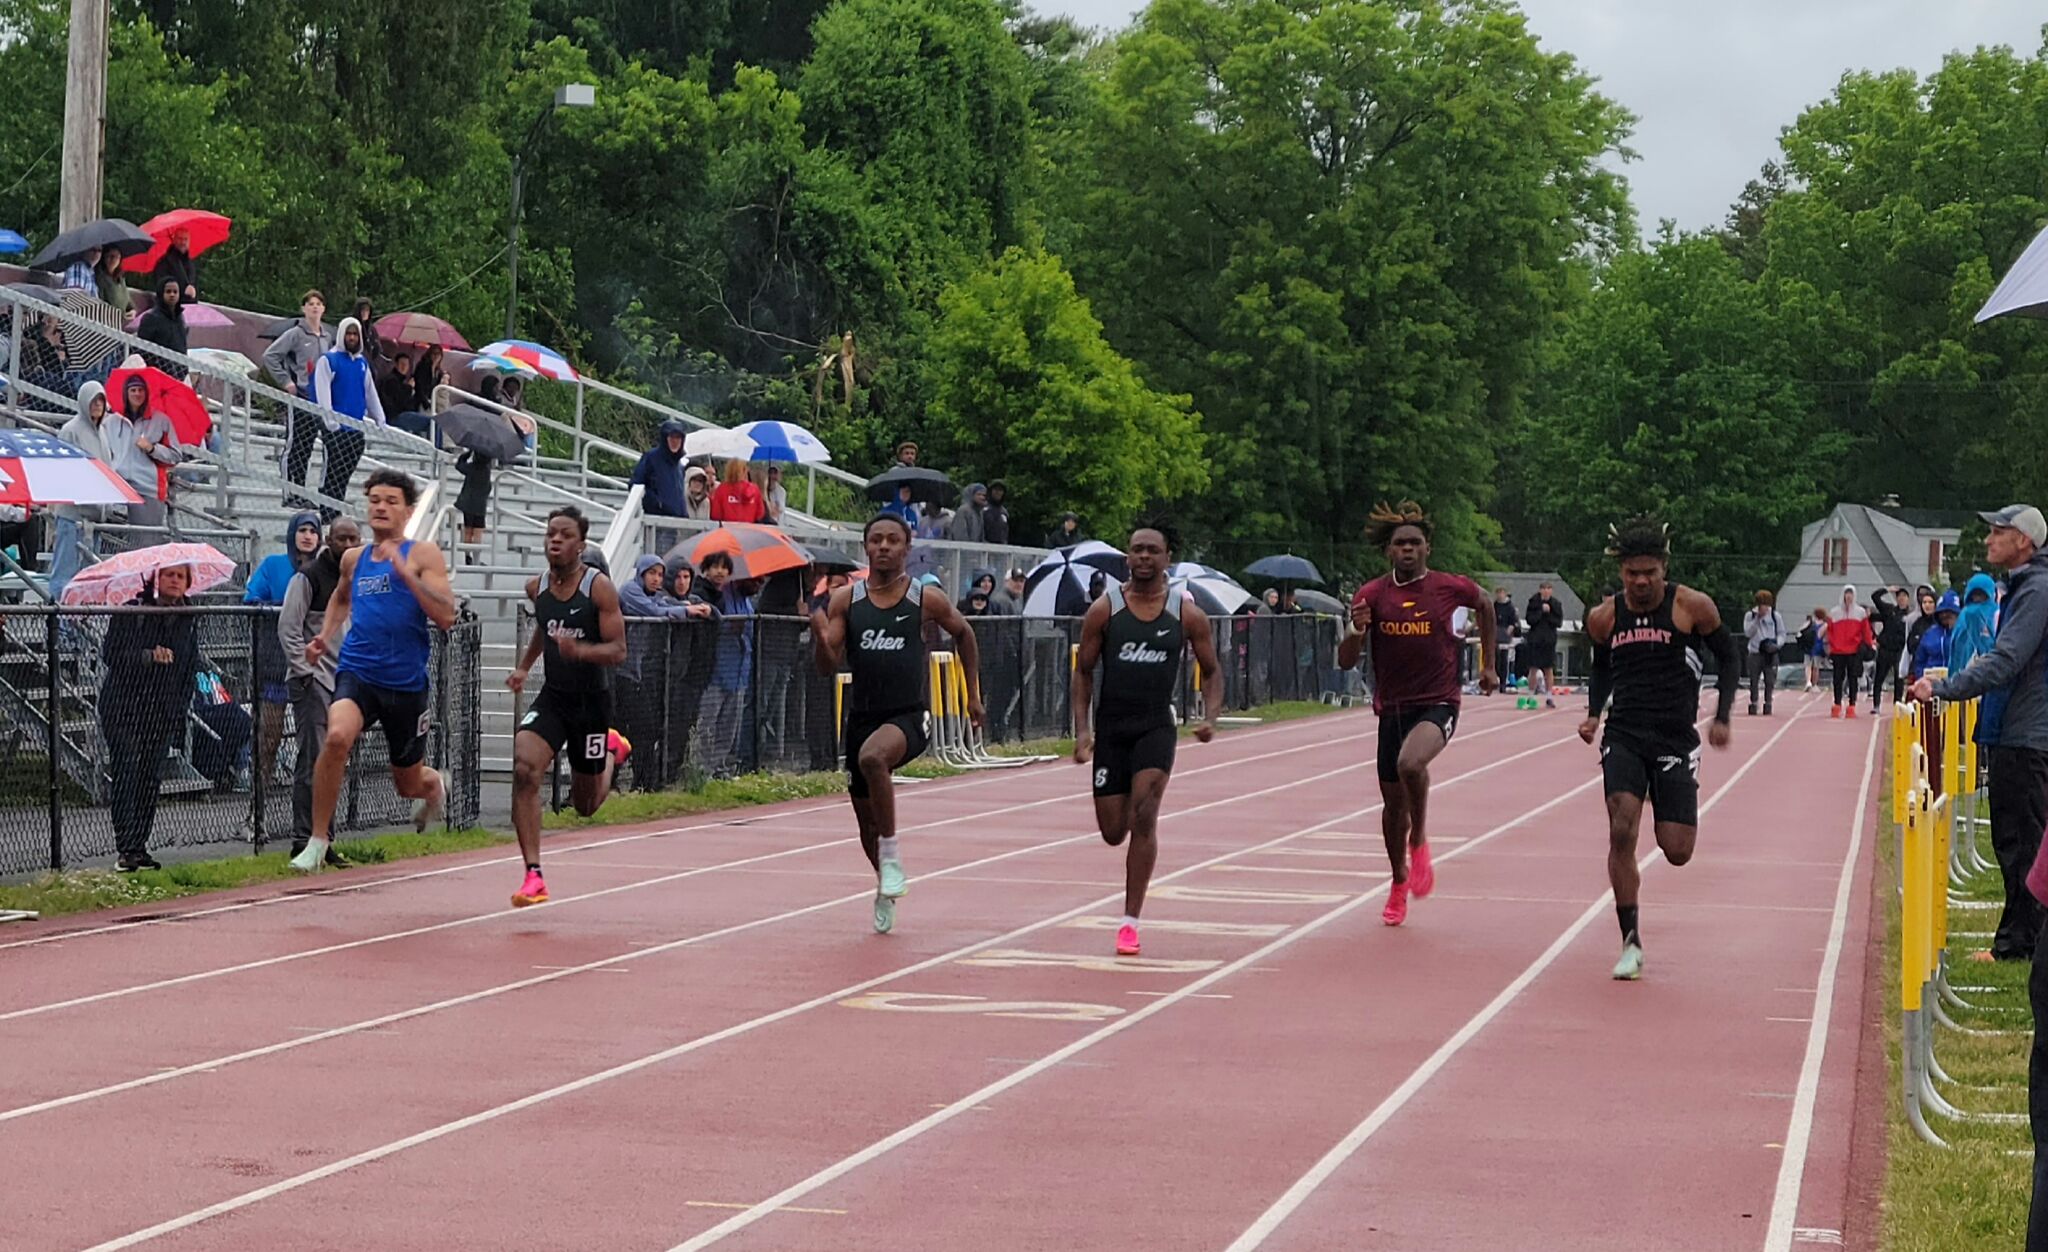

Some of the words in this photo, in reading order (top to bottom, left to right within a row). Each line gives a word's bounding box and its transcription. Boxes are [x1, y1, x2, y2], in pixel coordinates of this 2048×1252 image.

[546, 619, 586, 639] Shen
[1379, 621, 1431, 635] COLONIE
[1611, 627, 1672, 649] ACADEMY
[860, 628, 905, 650] Shen
[1118, 641, 1168, 663] Shen
[590, 736, 602, 757] 5
[1095, 767, 1108, 788] S
